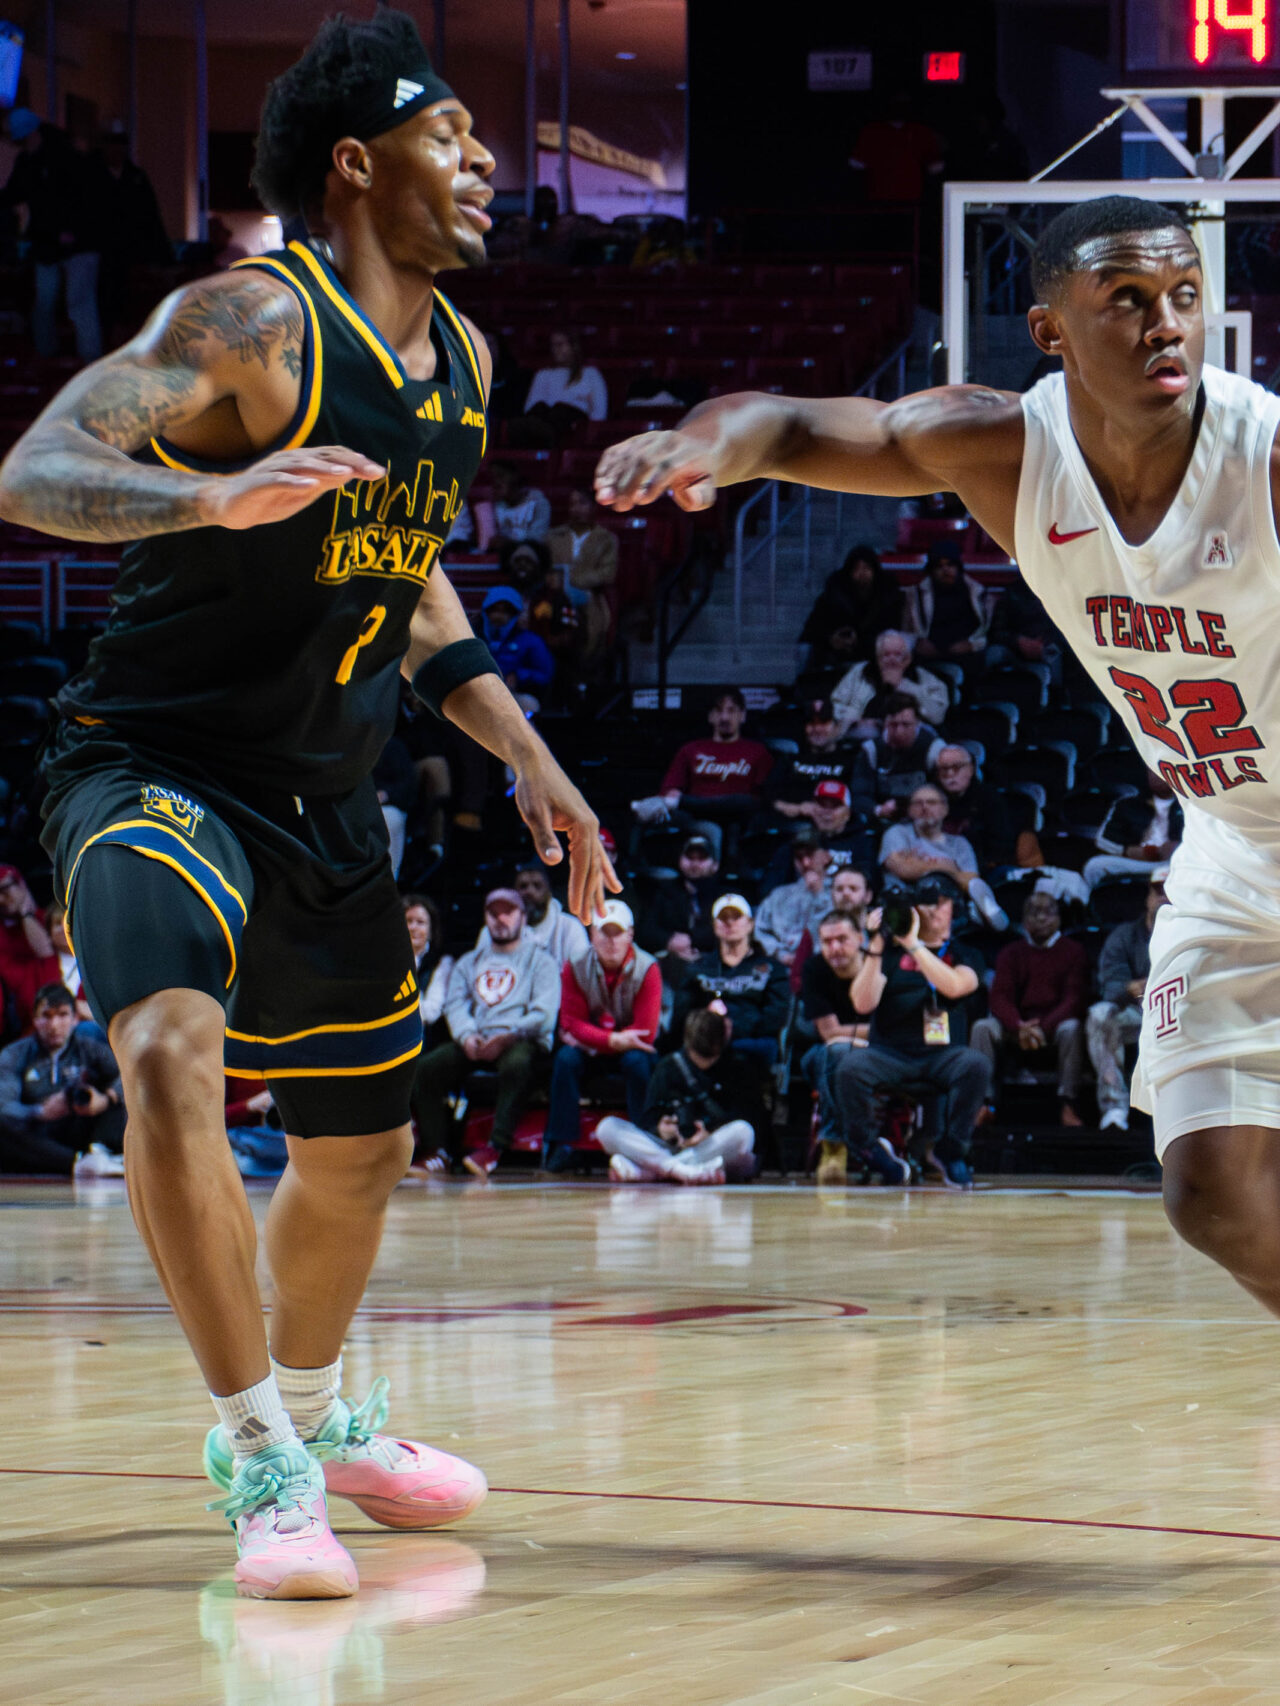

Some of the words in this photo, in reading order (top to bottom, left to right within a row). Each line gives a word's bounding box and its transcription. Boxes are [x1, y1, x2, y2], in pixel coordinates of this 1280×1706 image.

[1194, 0, 1266, 63] 14
[1086, 595, 1236, 658] TEMPLE
[1107, 665, 1266, 760] 22
[696, 754, 752, 782] Temple
[1158, 756, 1268, 799] OWLS
[1149, 976, 1184, 1039] T
